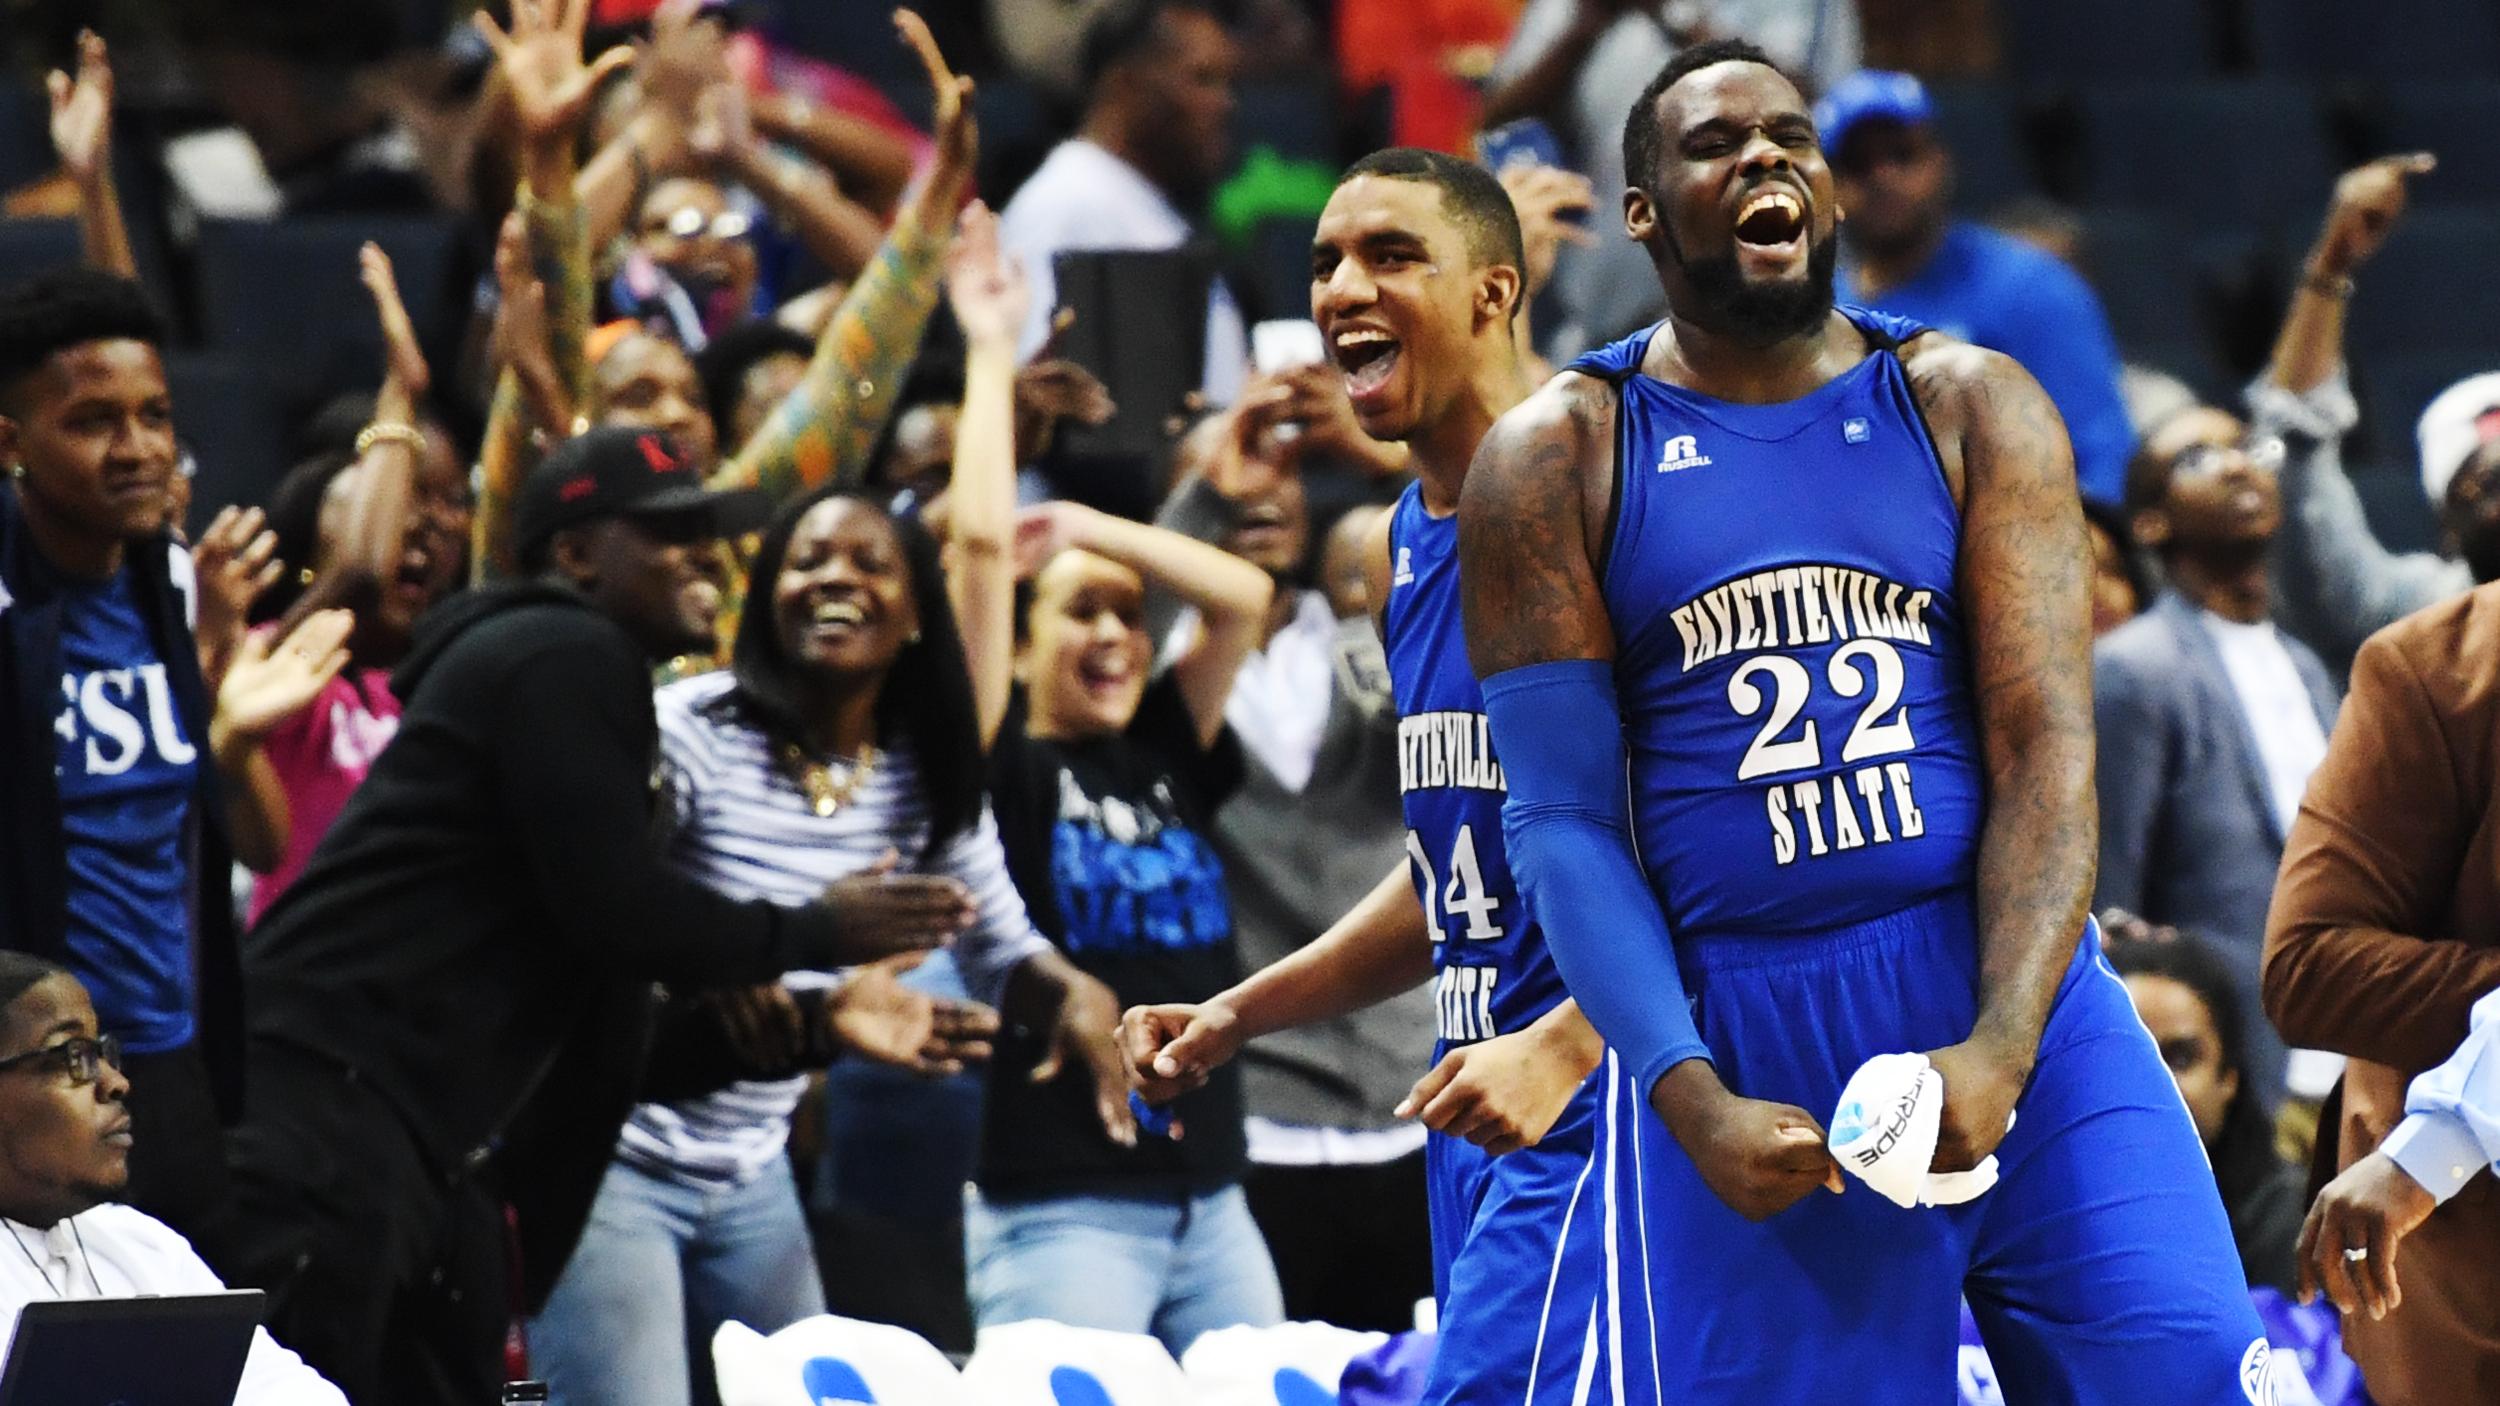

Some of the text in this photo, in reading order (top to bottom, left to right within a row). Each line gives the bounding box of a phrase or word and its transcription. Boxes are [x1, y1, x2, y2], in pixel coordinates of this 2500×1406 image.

[1657, 455, 1713, 473] RUSSELL
[1669, 565, 1932, 673] FAYETTEVILLE
[1727, 638, 1916, 781] 22
[1766, 761, 1925, 866] STATE
[1406, 824, 1503, 942] 14
